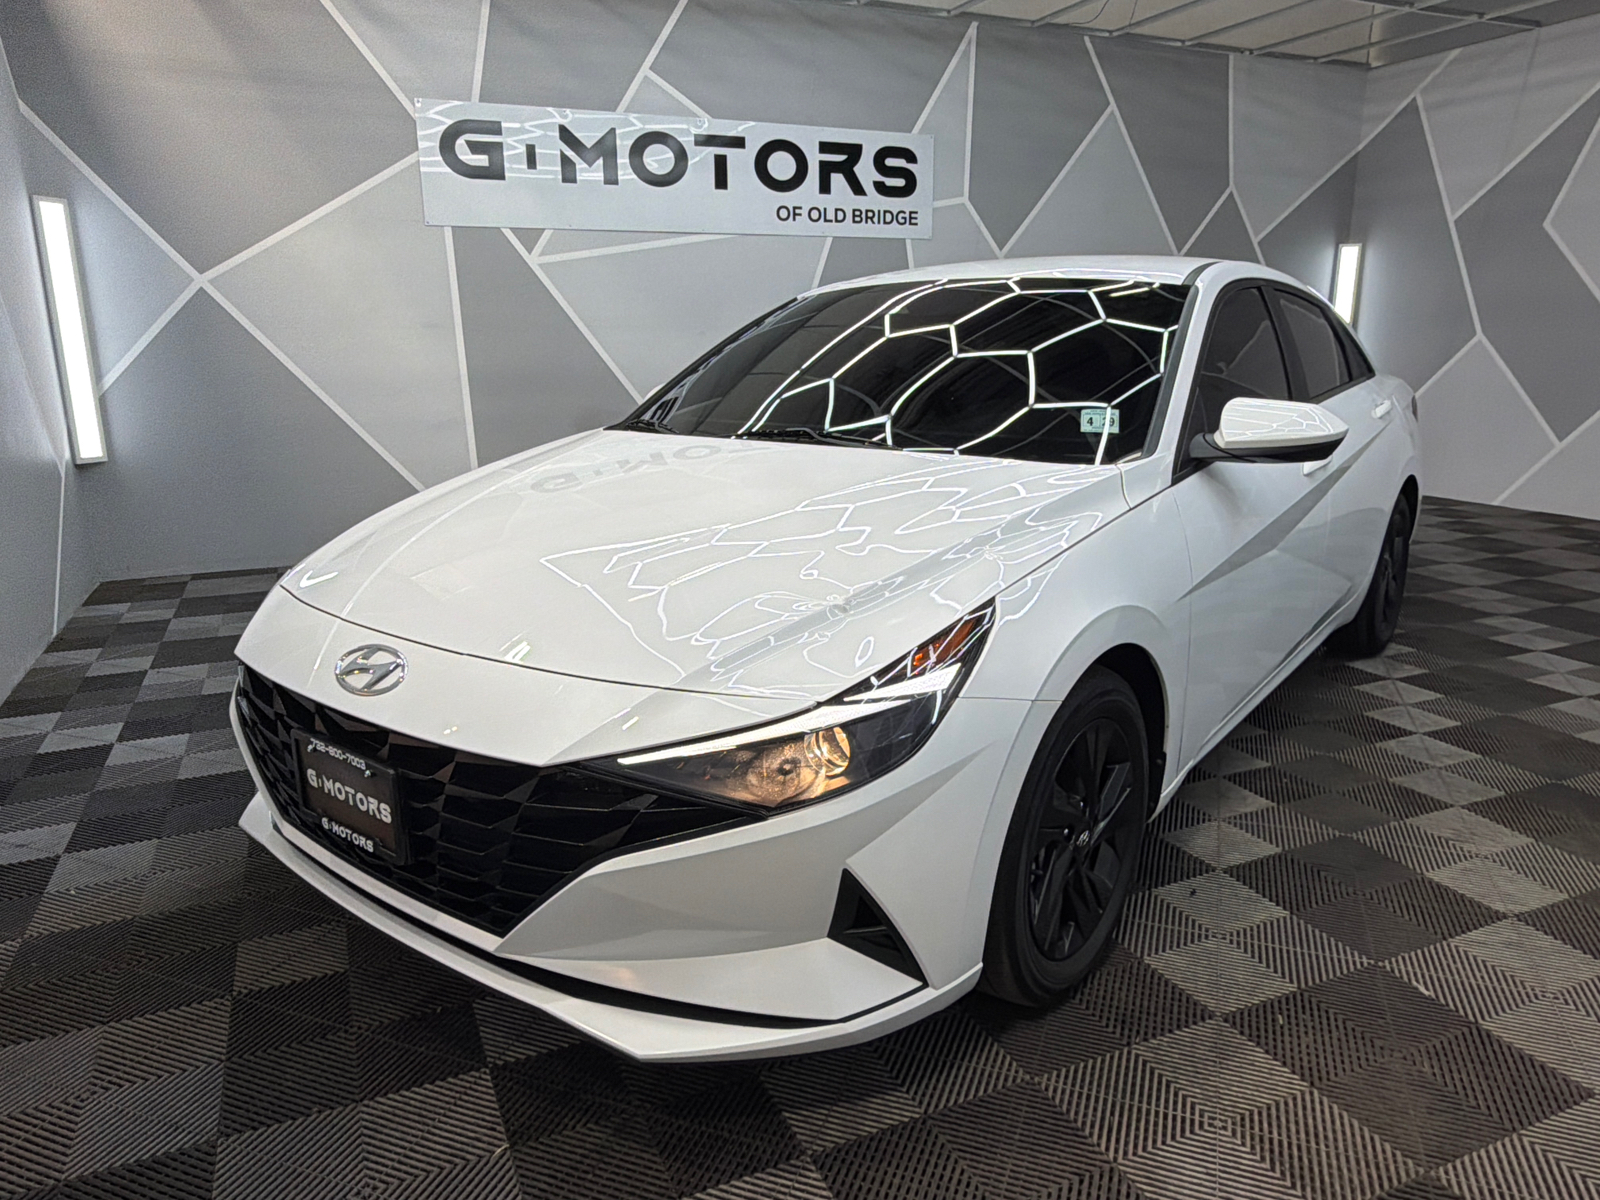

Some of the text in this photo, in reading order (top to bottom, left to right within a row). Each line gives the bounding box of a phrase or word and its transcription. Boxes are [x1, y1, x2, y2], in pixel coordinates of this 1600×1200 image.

[776, 205, 919, 227] OF OLD BRIDGE
[1086, 416, 1094, 427] 4
